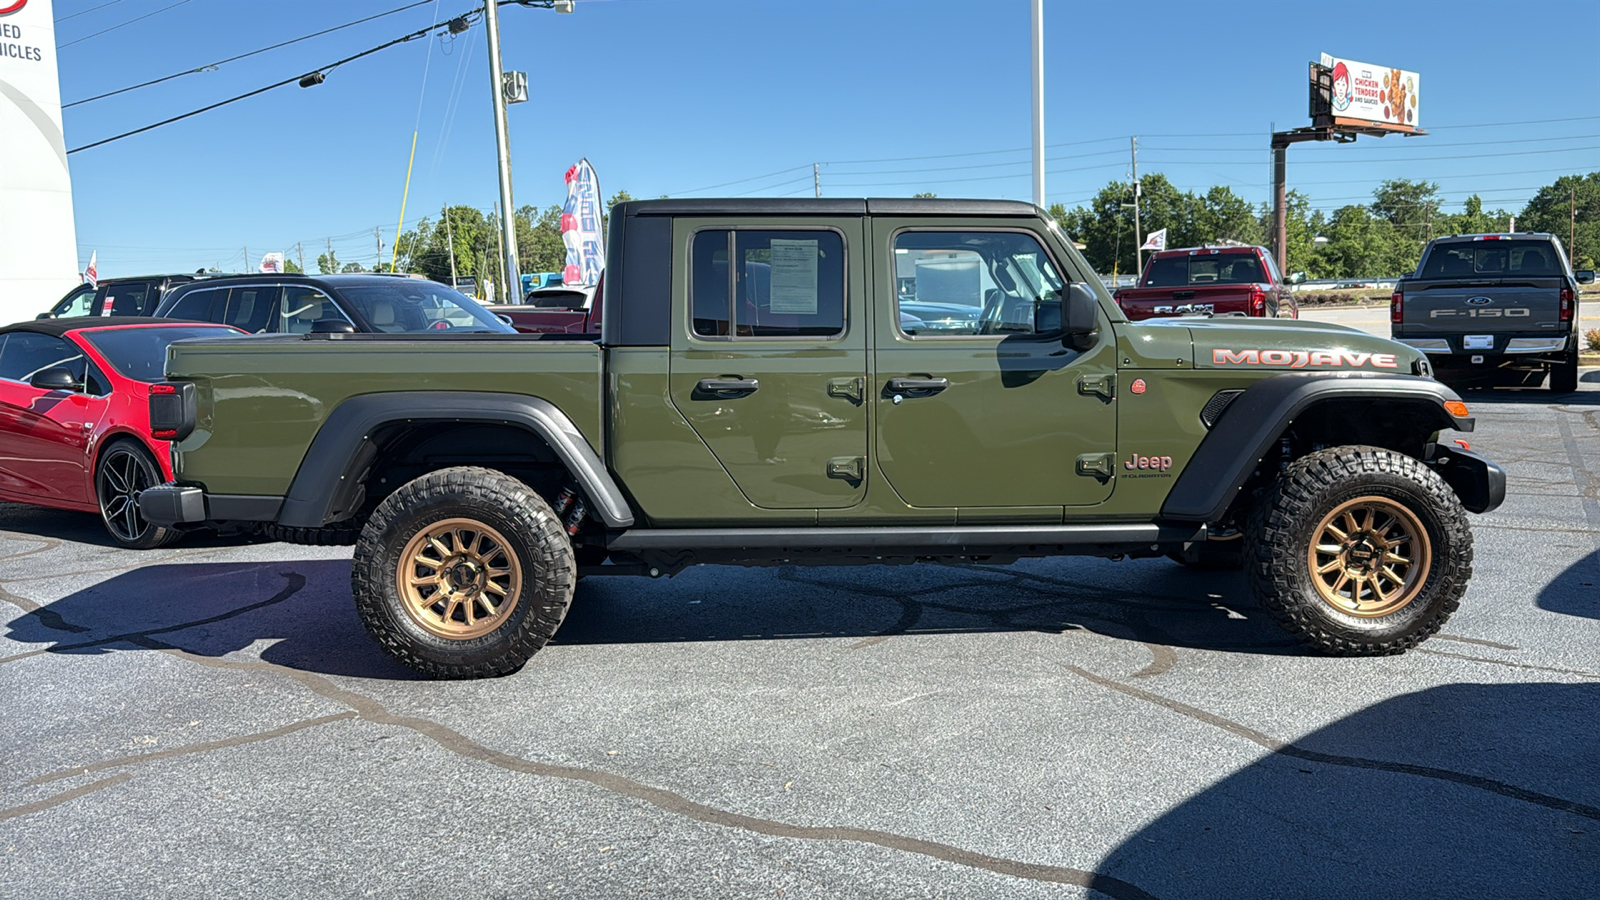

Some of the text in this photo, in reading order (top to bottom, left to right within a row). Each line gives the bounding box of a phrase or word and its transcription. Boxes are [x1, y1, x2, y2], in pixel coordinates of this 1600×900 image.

[1354, 77, 1379, 88] CHICKEN
[1354, 87, 1379, 98] TENDERS
[1363, 97, 1378, 105] SAUCES
[1153, 304, 1214, 316] RAM
[1430, 308, 1530, 318] F-150
[1213, 349, 1398, 368] MOJAVE
[1124, 453, 1172, 472] Jeep
